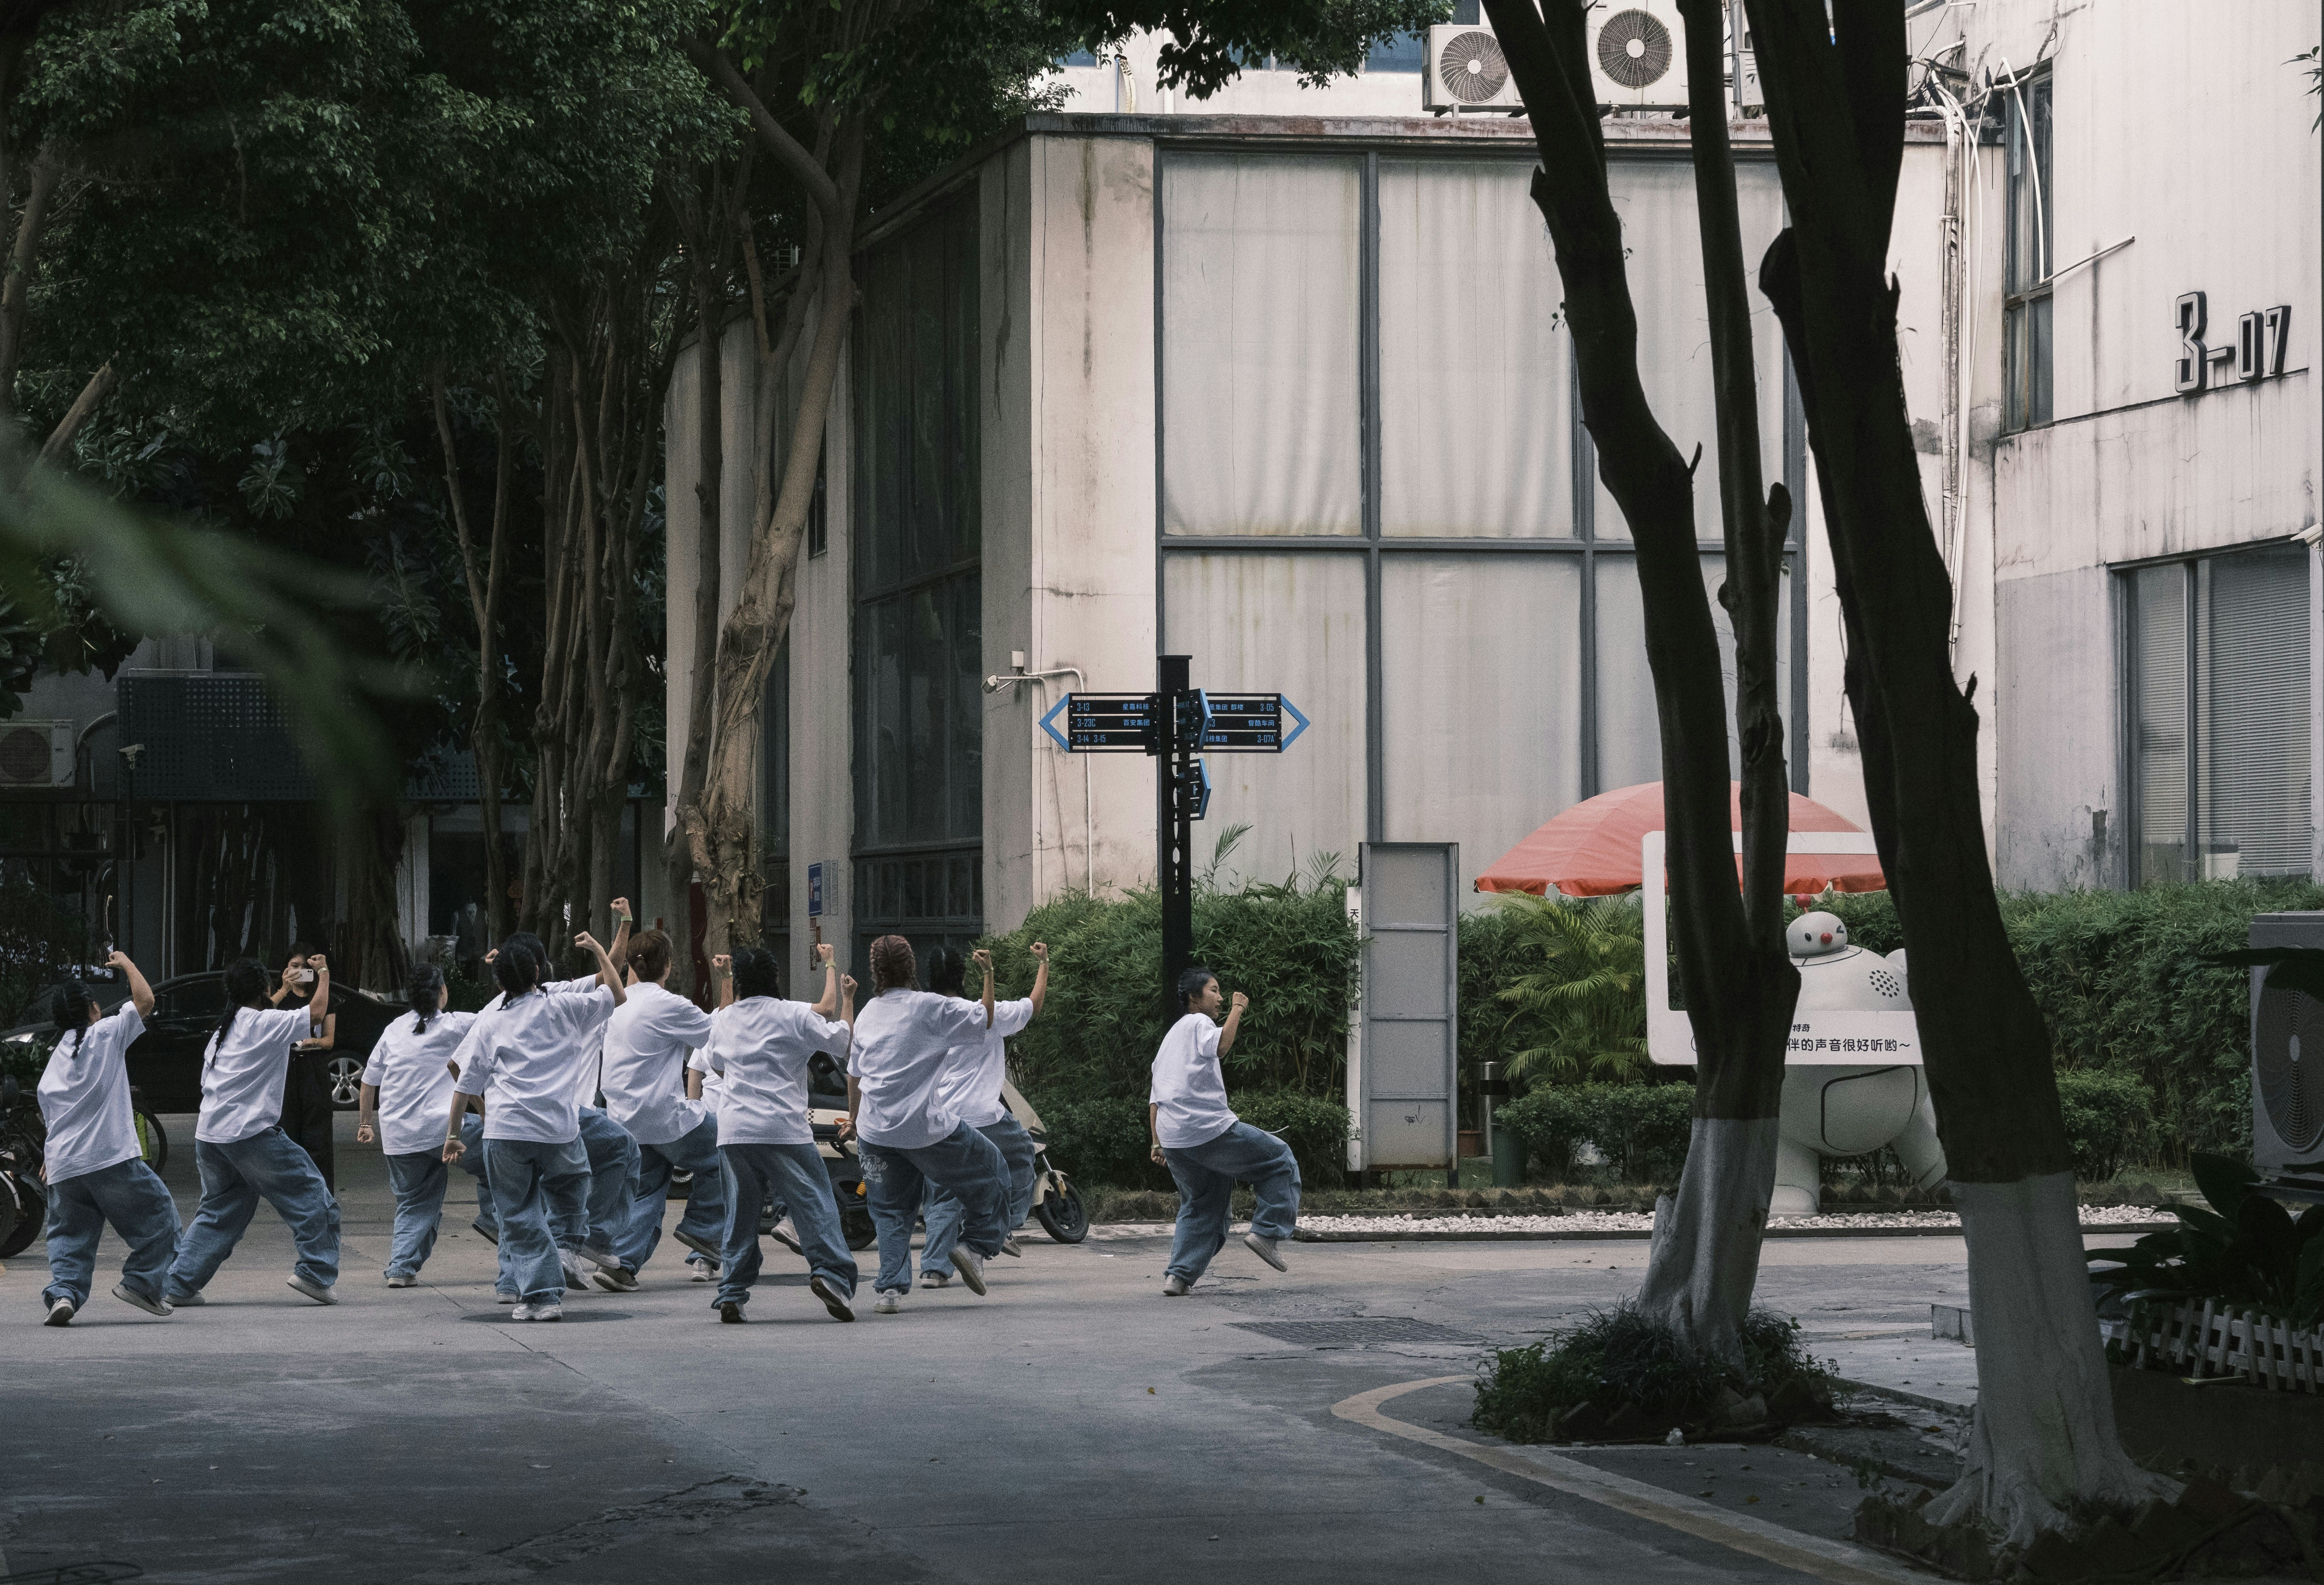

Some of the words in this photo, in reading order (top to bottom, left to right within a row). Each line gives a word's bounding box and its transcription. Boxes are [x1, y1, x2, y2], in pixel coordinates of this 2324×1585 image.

[2176, 291, 2291, 393] 3-07
[1077, 703, 1090, 711] 3-13
[1260, 703, 1274, 712] 3-05
[1077, 718, 1096, 727] 3-23C
[1077, 734, 1089, 743] 3-14
[1094, 734, 1106, 743] 3-15
[1257, 735, 1275, 743] 3-07A
[1792, 1023, 1810, 1033] 特奇
